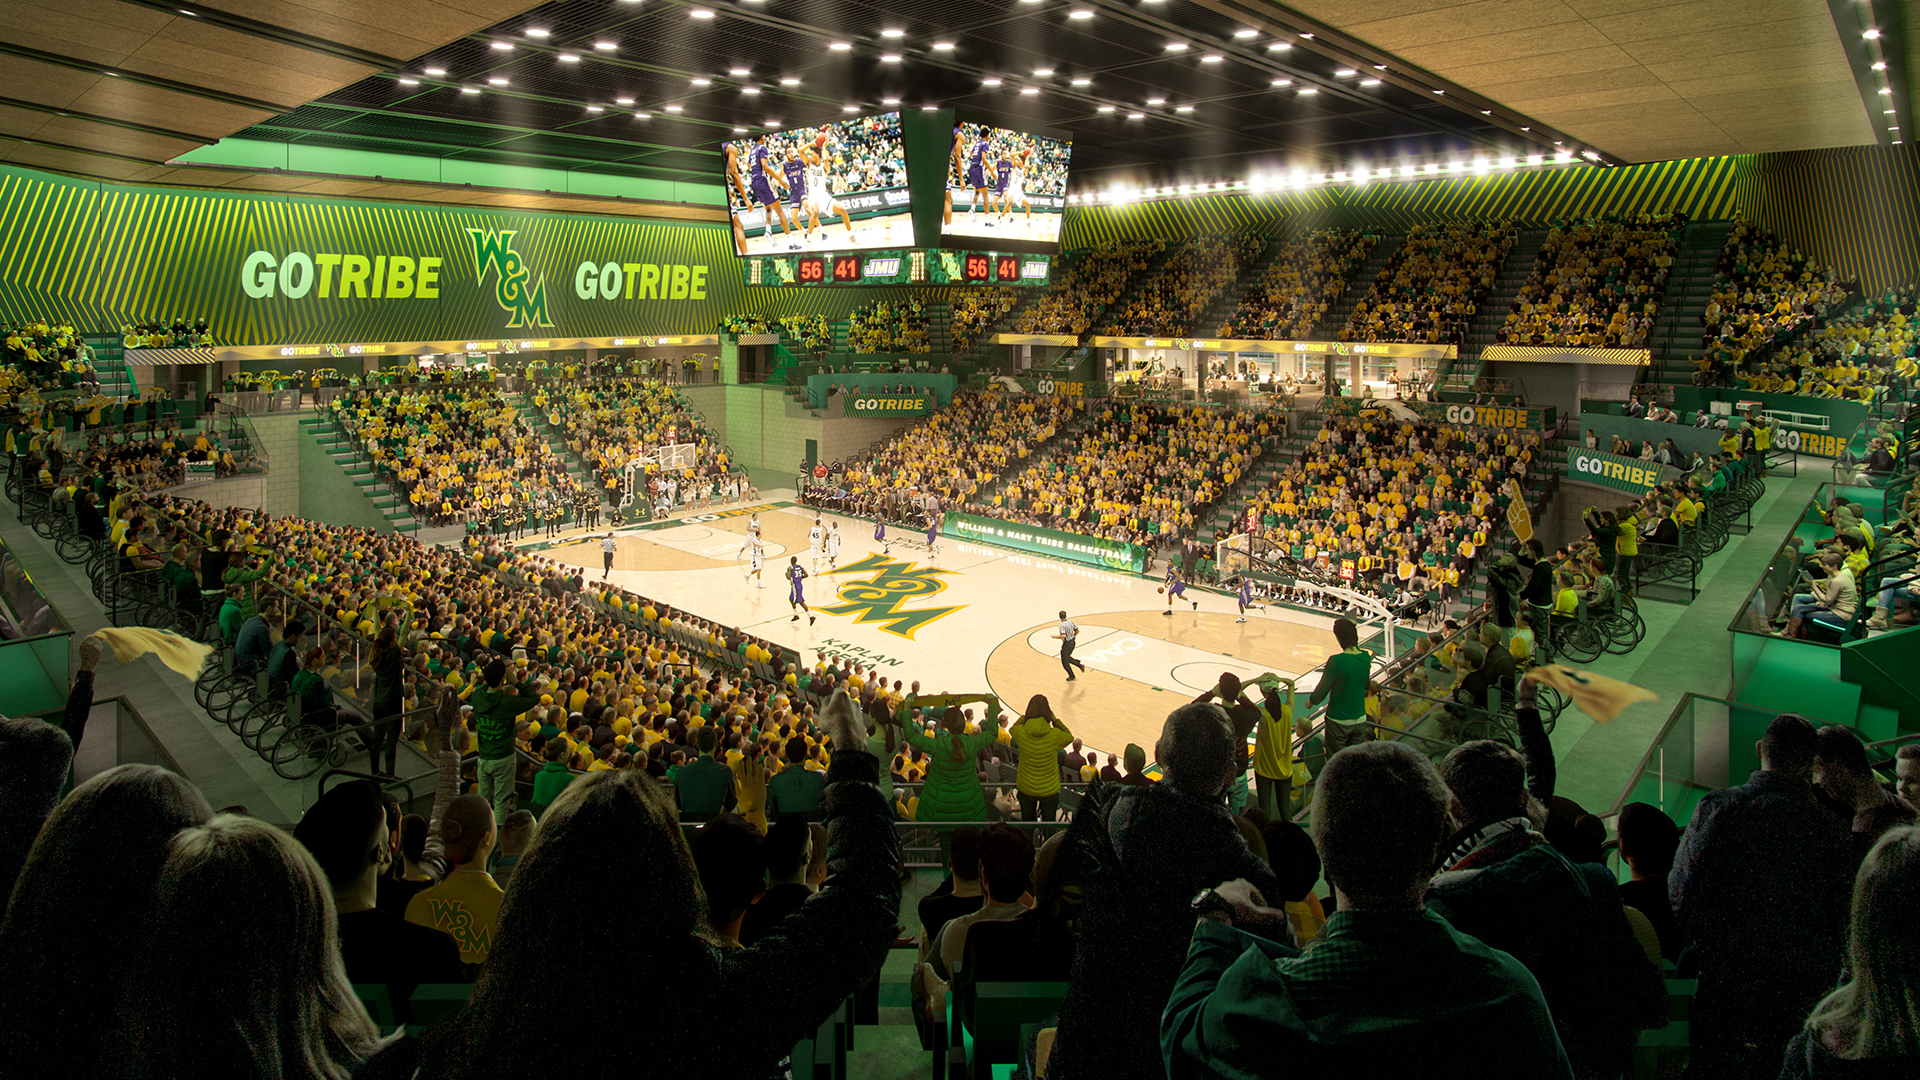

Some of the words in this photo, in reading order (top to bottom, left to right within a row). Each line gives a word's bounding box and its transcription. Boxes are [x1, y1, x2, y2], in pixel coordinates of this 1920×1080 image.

[800, 261, 822, 279] 56
[835, 259, 857, 278] 41
[864, 258, 901, 276] JMU
[967, 258, 988, 278] 56
[998, 260, 1016, 278] 41
[1022, 261, 1048, 279] JMU
[957, 521, 995, 535] WILLIAM
[997, 529, 1004, 537] &
[1007, 531, 1033, 542] MARY
[1036, 536, 1064, 548] TRIBE
[1067, 542, 1133, 562] BASKETBALL
[808, 646, 877, 671] ARENA
[821, 637, 905, 667] KAPLAN
